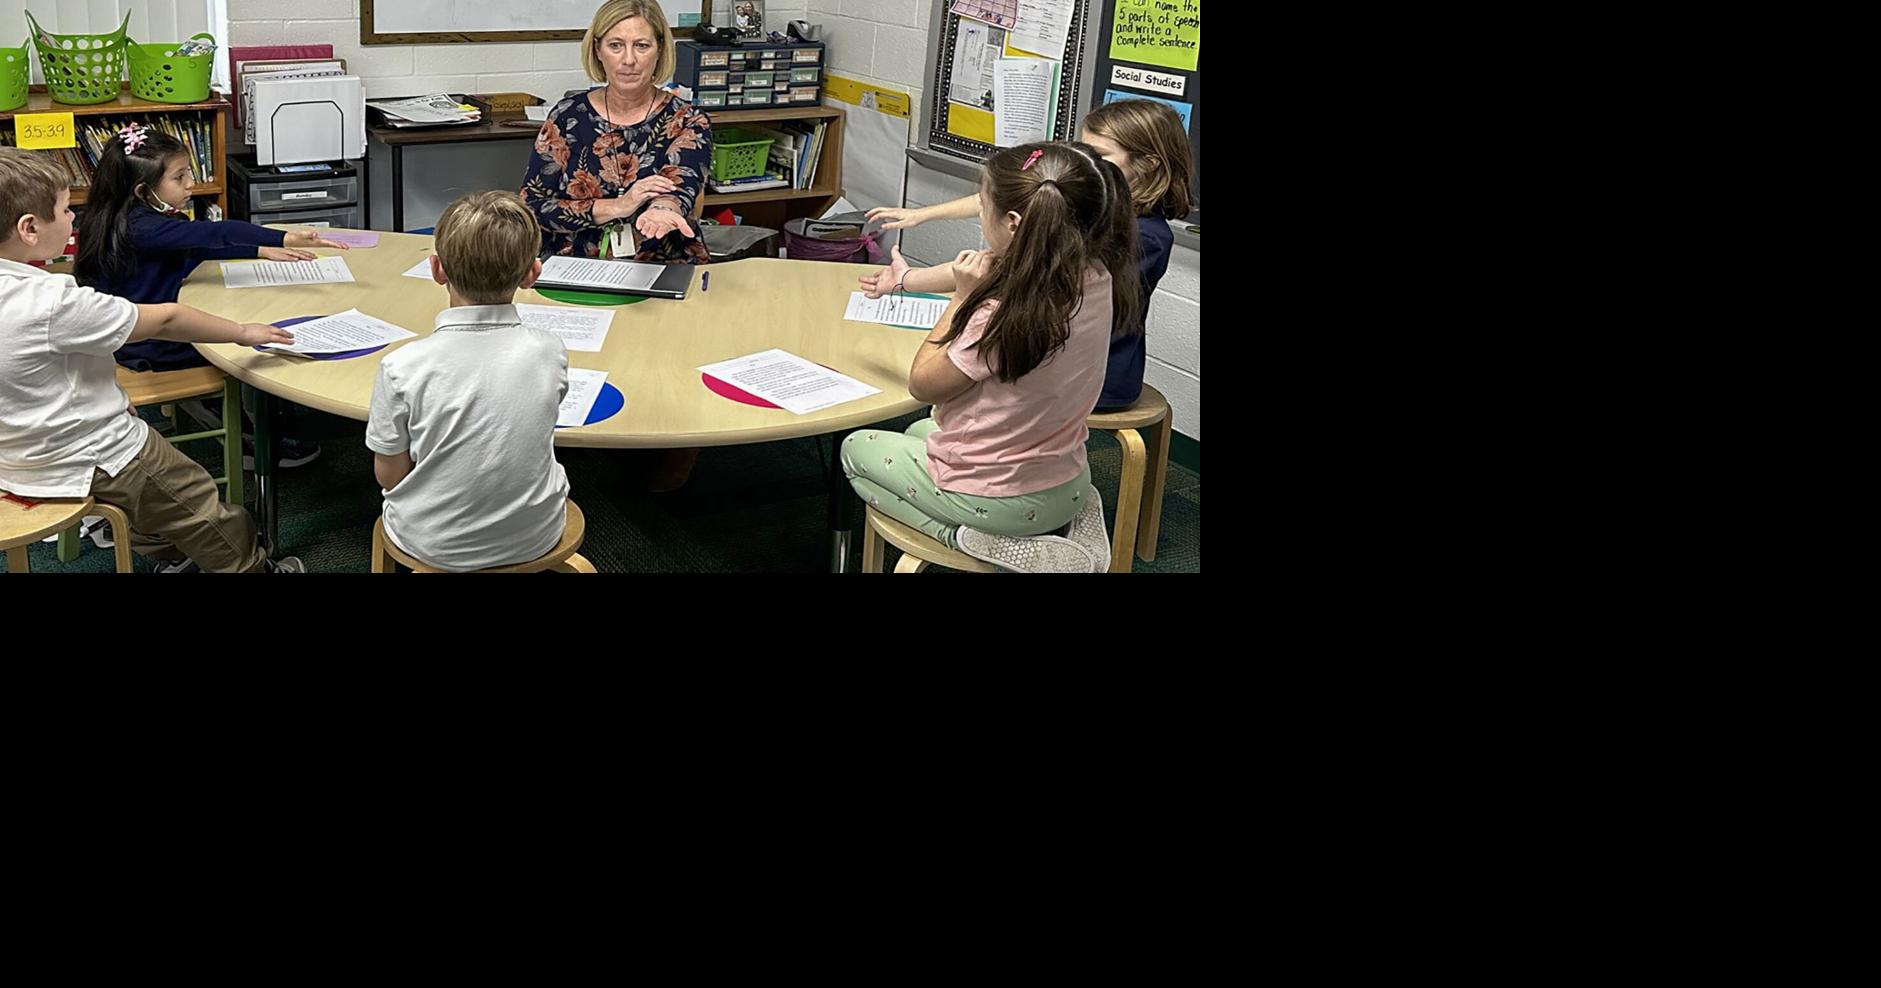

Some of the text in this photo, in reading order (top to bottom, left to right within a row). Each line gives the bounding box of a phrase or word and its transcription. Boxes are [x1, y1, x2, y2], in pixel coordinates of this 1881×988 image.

[1155, 1, 1178, 12] name
[1183, 0, 1198, 12] the
[1119, 7, 1126, 20] 5
[1128, 10, 1153, 24] parts
[1158, 12, 1170, 23] of
[1116, 22, 1172, 36] and write a
[1159, 35, 1196, 49] sentence
[1115, 69, 1182, 89] Social Studies
